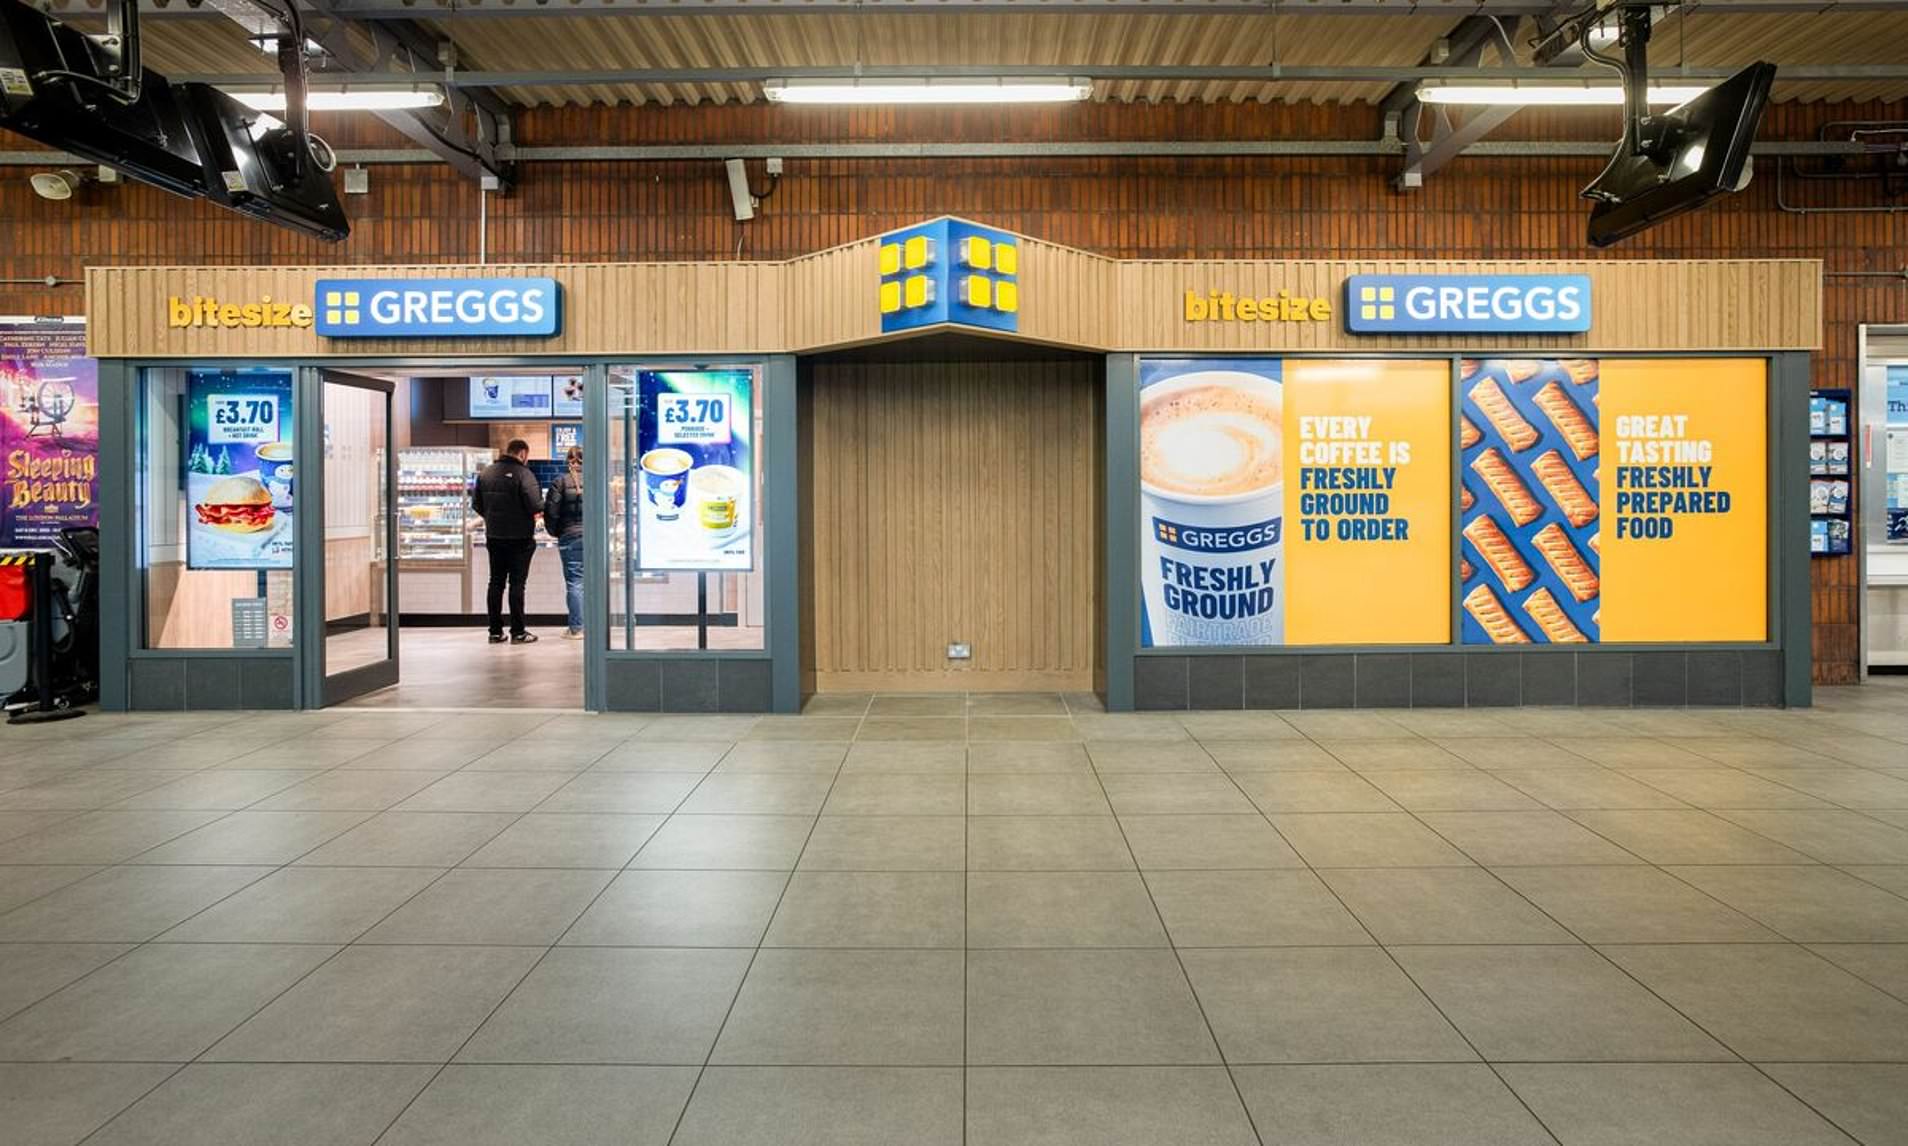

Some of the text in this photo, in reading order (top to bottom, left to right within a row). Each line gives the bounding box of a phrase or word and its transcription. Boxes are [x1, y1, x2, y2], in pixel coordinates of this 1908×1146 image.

[169, 289, 544, 328] bitesize GREGGS
[1184, 286, 1581, 321] bitesize GREGGS
[215, 400, 273, 424] £3.70
[665, 399, 724, 423] £3.70
[1300, 416, 1372, 439] EVERY
[1616, 416, 1688, 438] GREAT
[1300, 441, 1411, 464] COFFEE IS
[1617, 441, 1712, 463] TASTING
[8, 449, 95, 481] Sleeping
[1300, 467, 1397, 490] FRESHLY
[1617, 466, 1712, 488] FRESHLY
[5, 480, 91, 509] Beauty
[1300, 493, 1389, 515] GROUND
[1617, 491, 1731, 513] PREPARED
[1182, 524, 1276, 548] GREGGS
[1301, 518, 1409, 541] TO ORDER
[1617, 517, 1673, 539] FOOD
[1160, 555, 1277, 592] FRESHLY
[1163, 583, 1274, 620] GROUND
